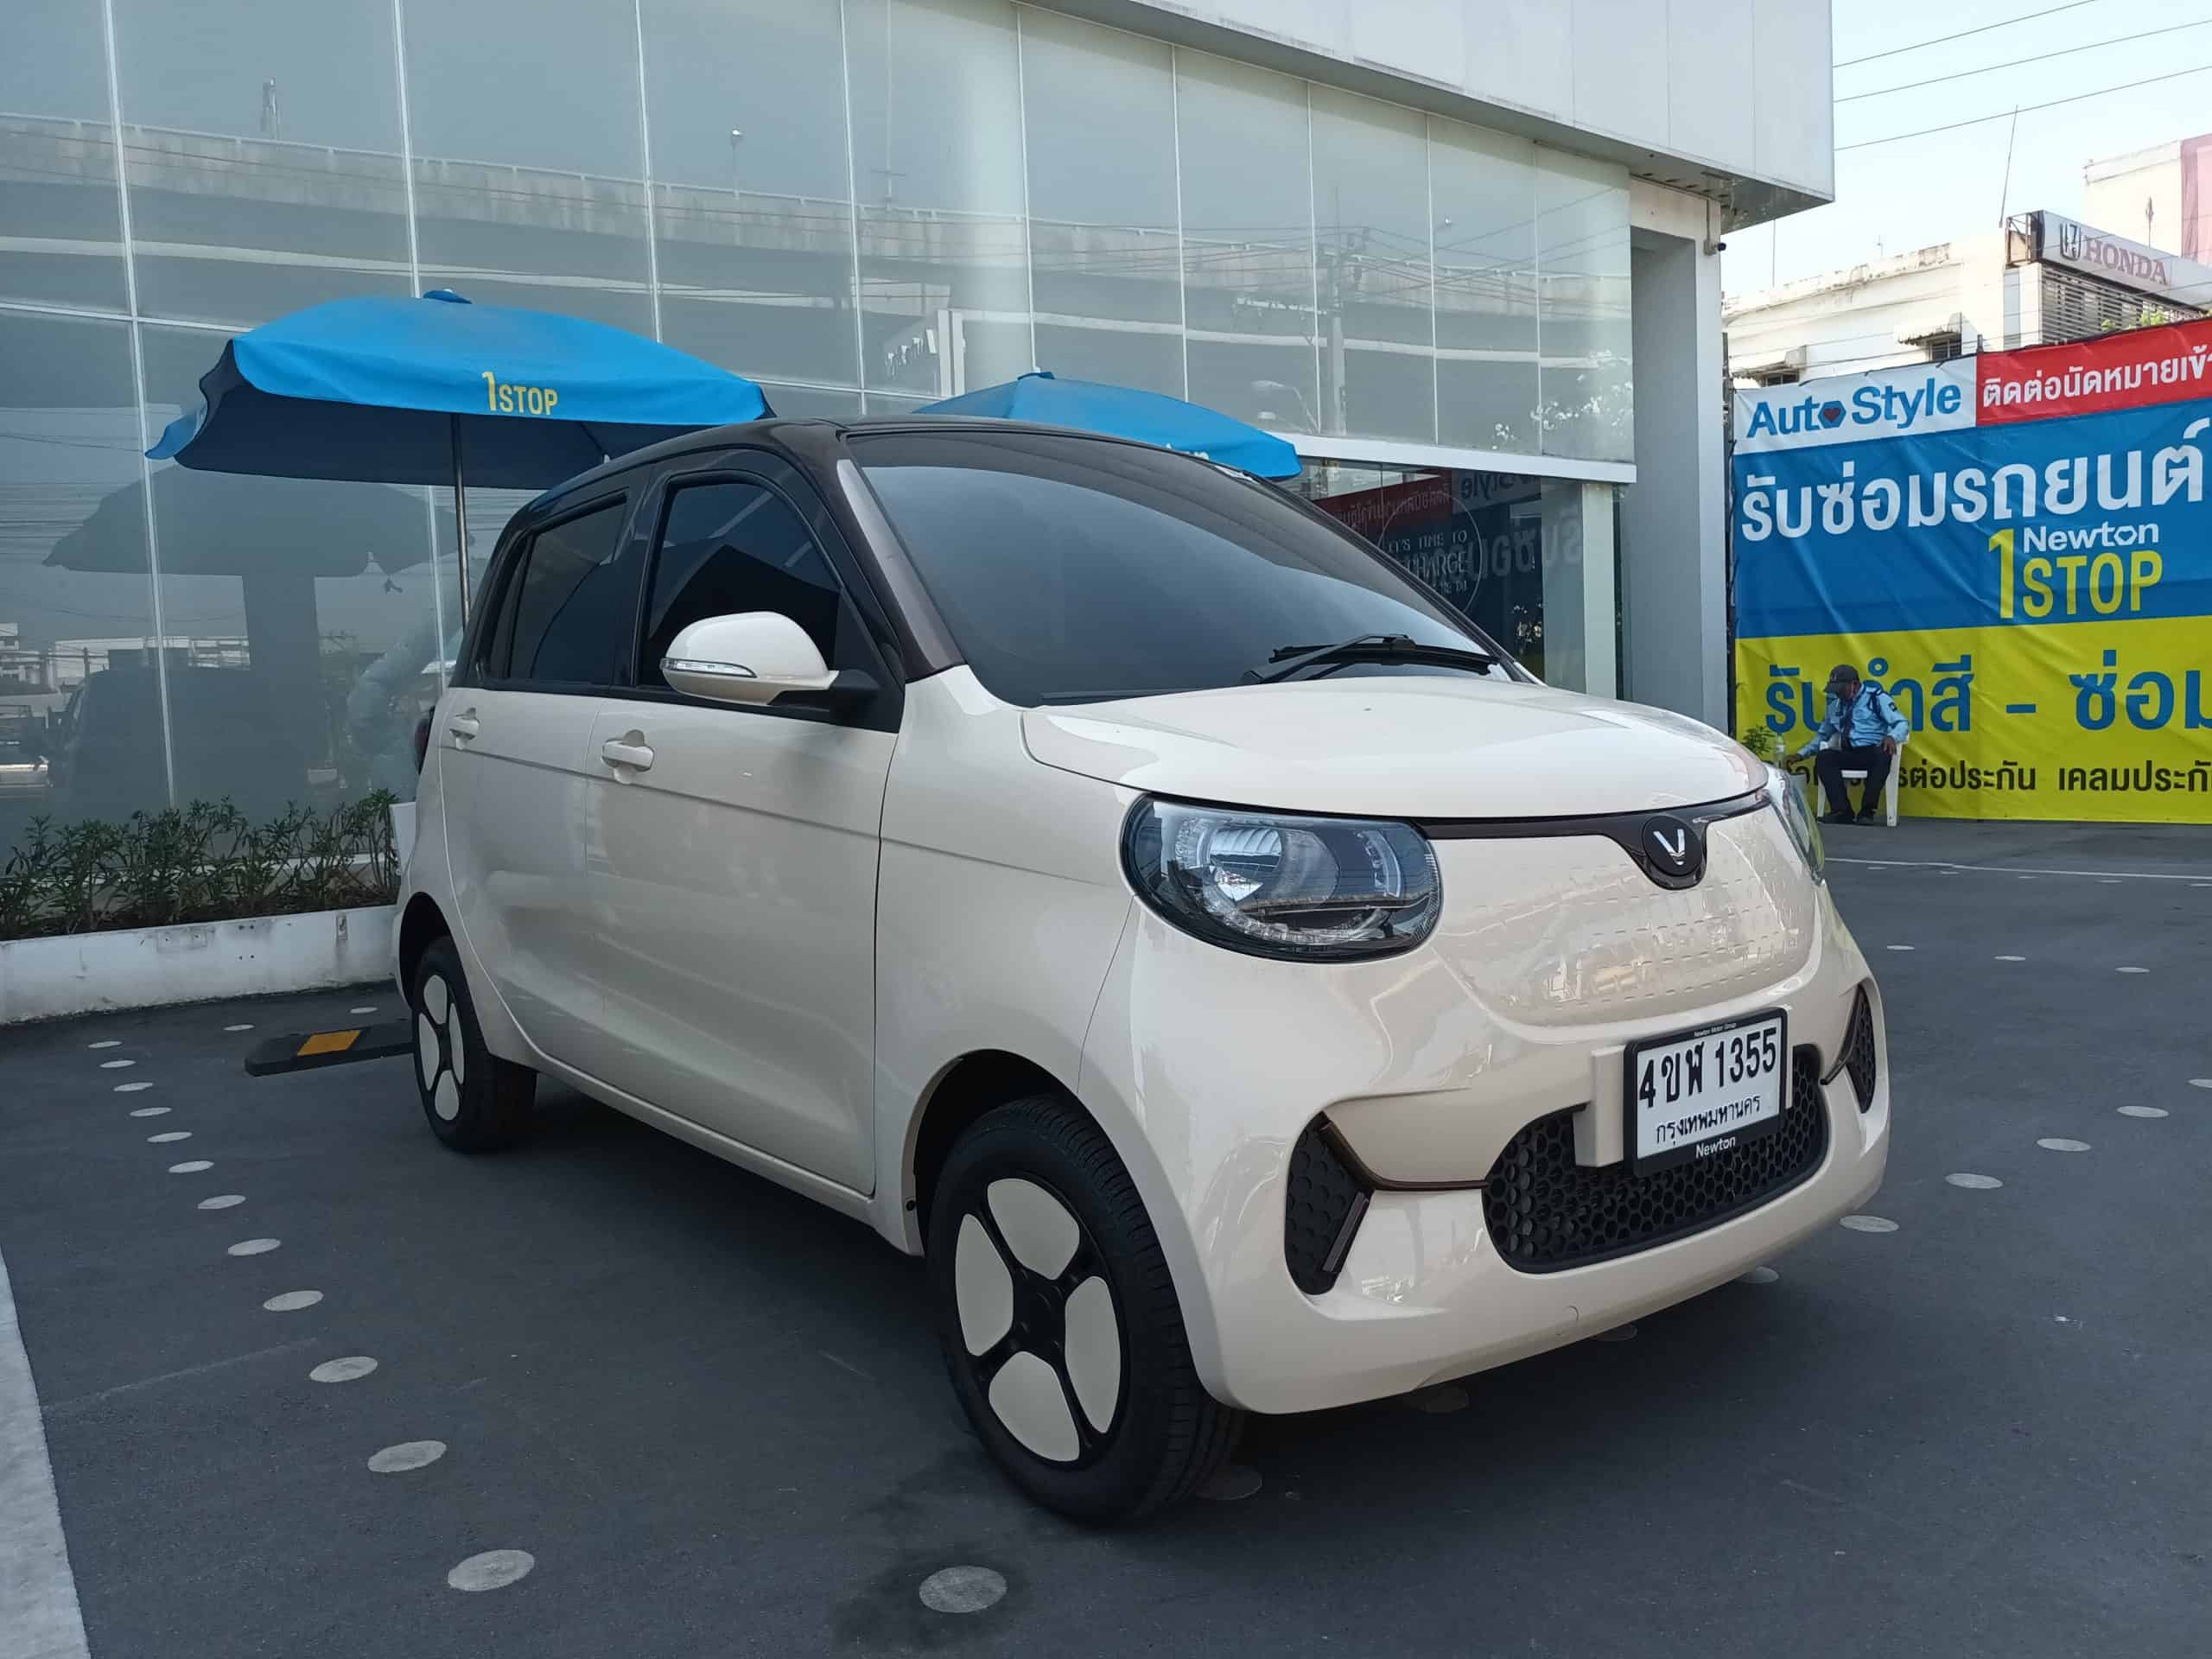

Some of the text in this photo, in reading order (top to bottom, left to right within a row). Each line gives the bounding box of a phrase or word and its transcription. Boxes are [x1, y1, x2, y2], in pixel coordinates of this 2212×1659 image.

[2083, 235, 2169, 285] HONDA
[1983, 345, 2212, 408] ติดต่อนัดหมายเข้
[1742, 416, 2211, 542] รับซ่อมรถยนต์
[1418, 533, 1444, 550] TIME
[1452, 530, 1467, 543] TO
[2023, 521, 2159, 553] Newton
[2058, 760, 2212, 792] เคลมประกั
[1715, 1027, 1777, 1089] 1355
[1656, 1095, 1761, 1146] กรุงเทพมหานคร
[1695, 1136, 1736, 1159] Newton
